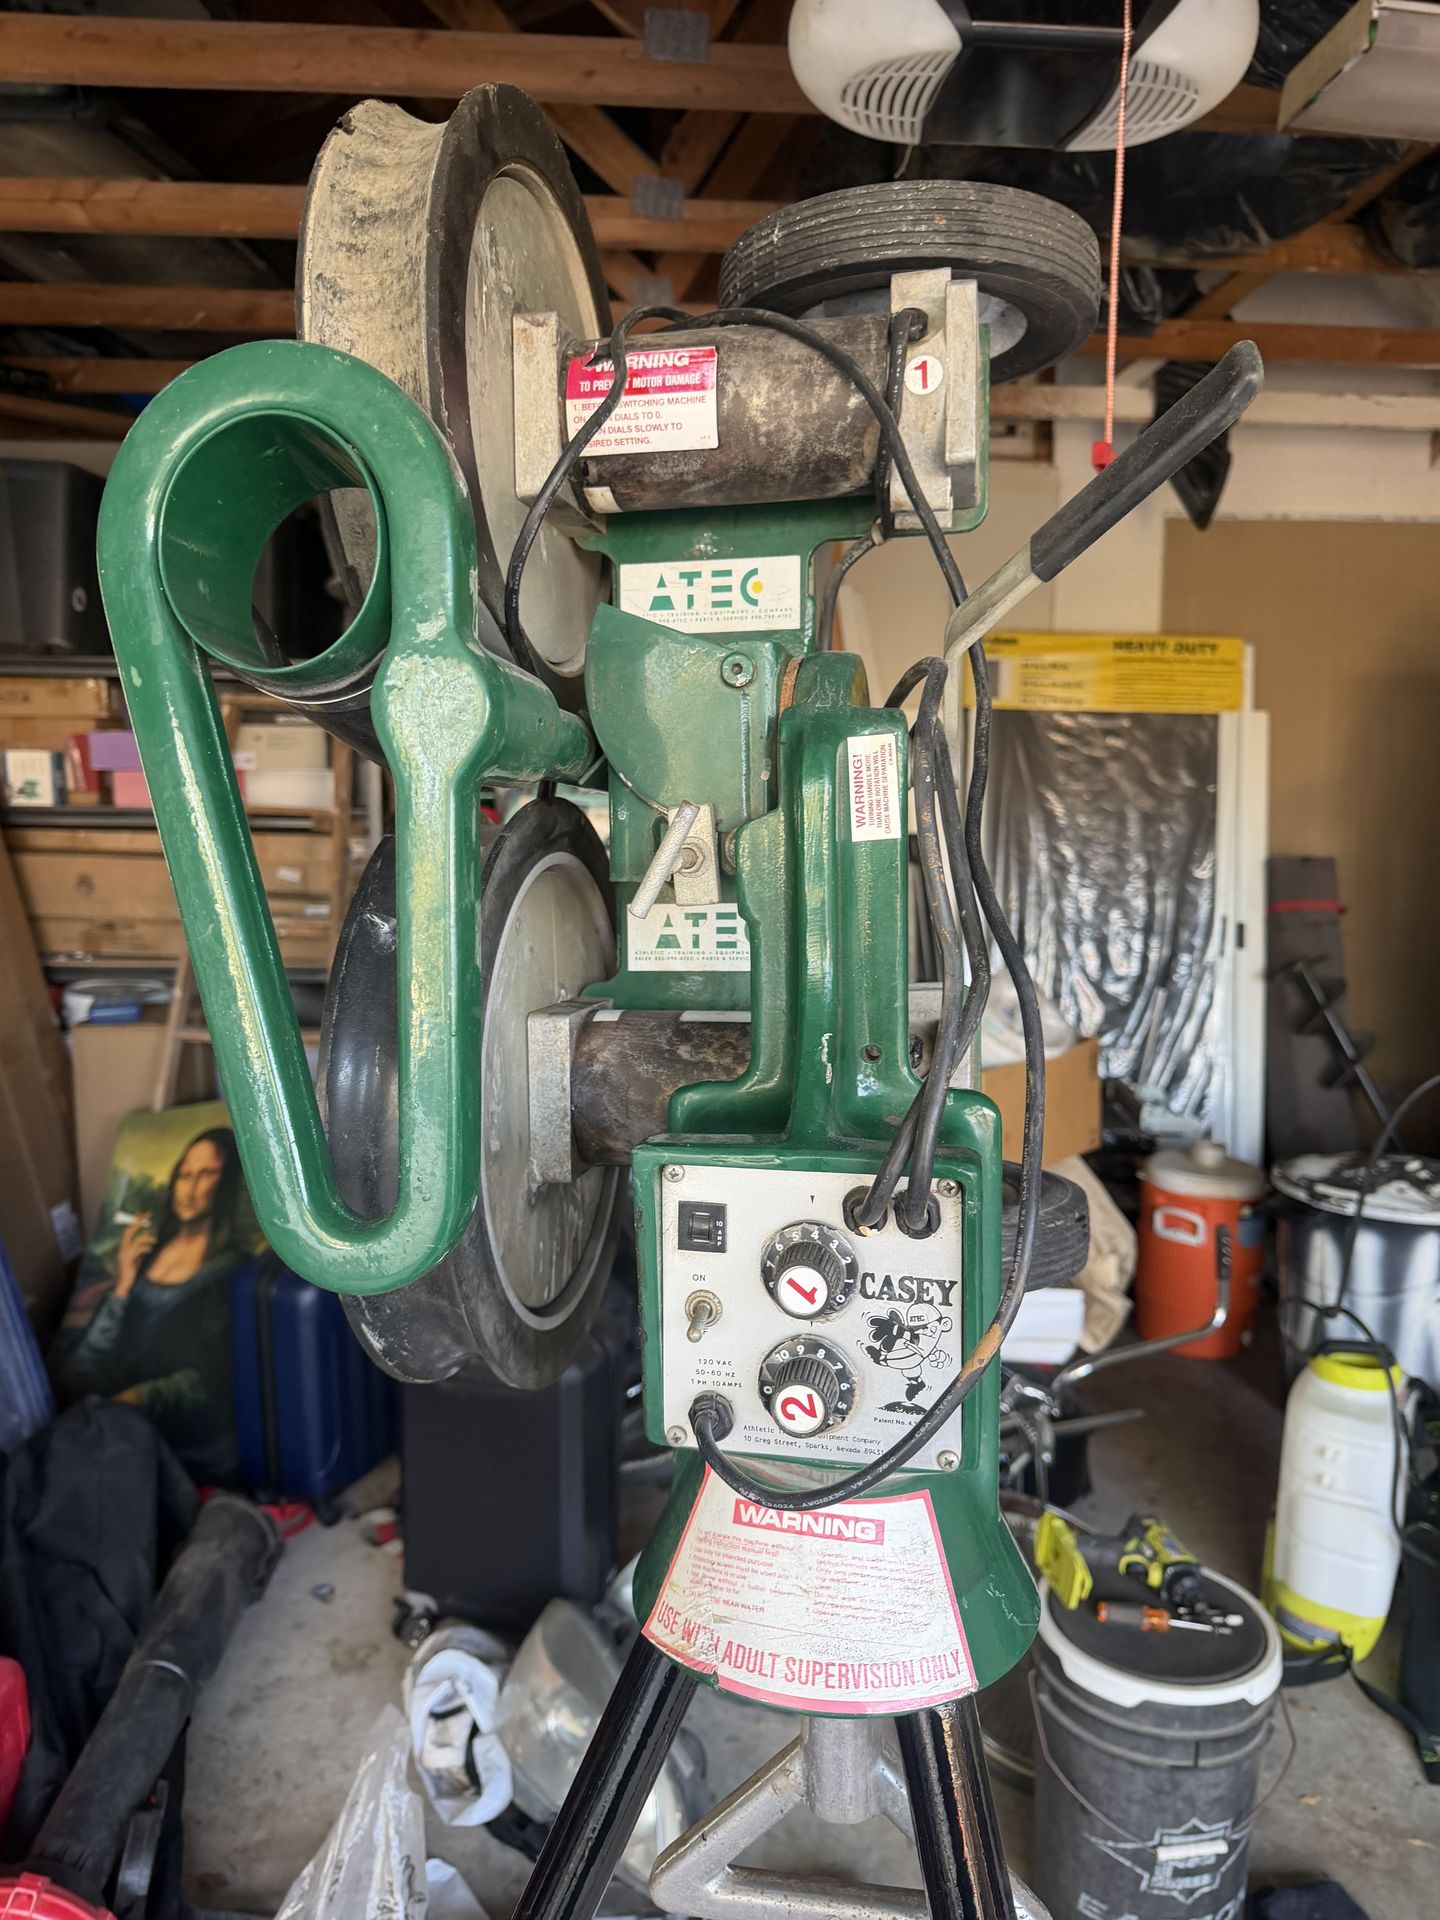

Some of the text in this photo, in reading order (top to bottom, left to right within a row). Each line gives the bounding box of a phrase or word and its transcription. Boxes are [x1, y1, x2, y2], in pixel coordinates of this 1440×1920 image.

[912, 360, 928, 389] 1
[579, 373, 701, 393] TO PREVT MOTOR DAMAGE
[667, 395, 707, 405] MACHINE
[614, 412, 640, 422] DIALS
[641, 411, 654, 420] TO
[608, 426, 633, 435] DIALS
[634, 423, 668, 433] SLOWLY
[670, 422, 683, 431] TO
[588, 439, 613, 449] SIRED
[649, 567, 760, 611] ATEC
[880, 744, 889, 783] SEPARATION
[852, 753, 866, 829] WARNING!
[882, 784, 890, 813] MACHINE
[791, 1232, 801, 1241] 5
[810, 1230, 820, 1240] 4
[775, 1241, 784, 1252] 6
[829, 1239, 839, 1249] 3
[766, 1260, 776, 1269] 7
[692, 1273, 706, 1283] ON
[786, 1277, 818, 1306] 1
[860, 1272, 958, 1307] CASEY
[835, 1294, 846, 1303] 0
[796, 1344, 805, 1356] 9
[816, 1348, 826, 1359] 8
[775, 1349, 790, 1363] 10
[698, 1358, 733, 1367] 120 VAC
[832, 1361, 844, 1371] 7
[695, 1368, 736, 1378] 50-60 HZ
[840, 1382, 851, 1391] 6
[780, 1393, 818, 1421] 2
[837, 1401, 847, 1410] 5
[873, 1416, 894, 1425] Patent
[895, 1418, 908, 1426] No.
[743, 1425, 775, 1434] Athletic
[814, 1433, 849, 1443] quipment
[852, 1436, 882, 1446] Company
[915, 1422, 931, 1438] CSA
[754, 1436, 771, 1446] Greg
[774, 1438, 801, 1449] Street,
[805, 1442, 833, 1452] Sparks,
[836, 1446, 861, 1454] Nevada
[863, 1448, 884, 1456] 89431
[739, 1503, 877, 1541] WARNING
[656, 1601, 682, 1635] USE
[721, 1640, 781, 1679] ADULT
[784, 1655, 915, 1690] SUPERVISION
[919, 1648, 961, 1684] ONLY
